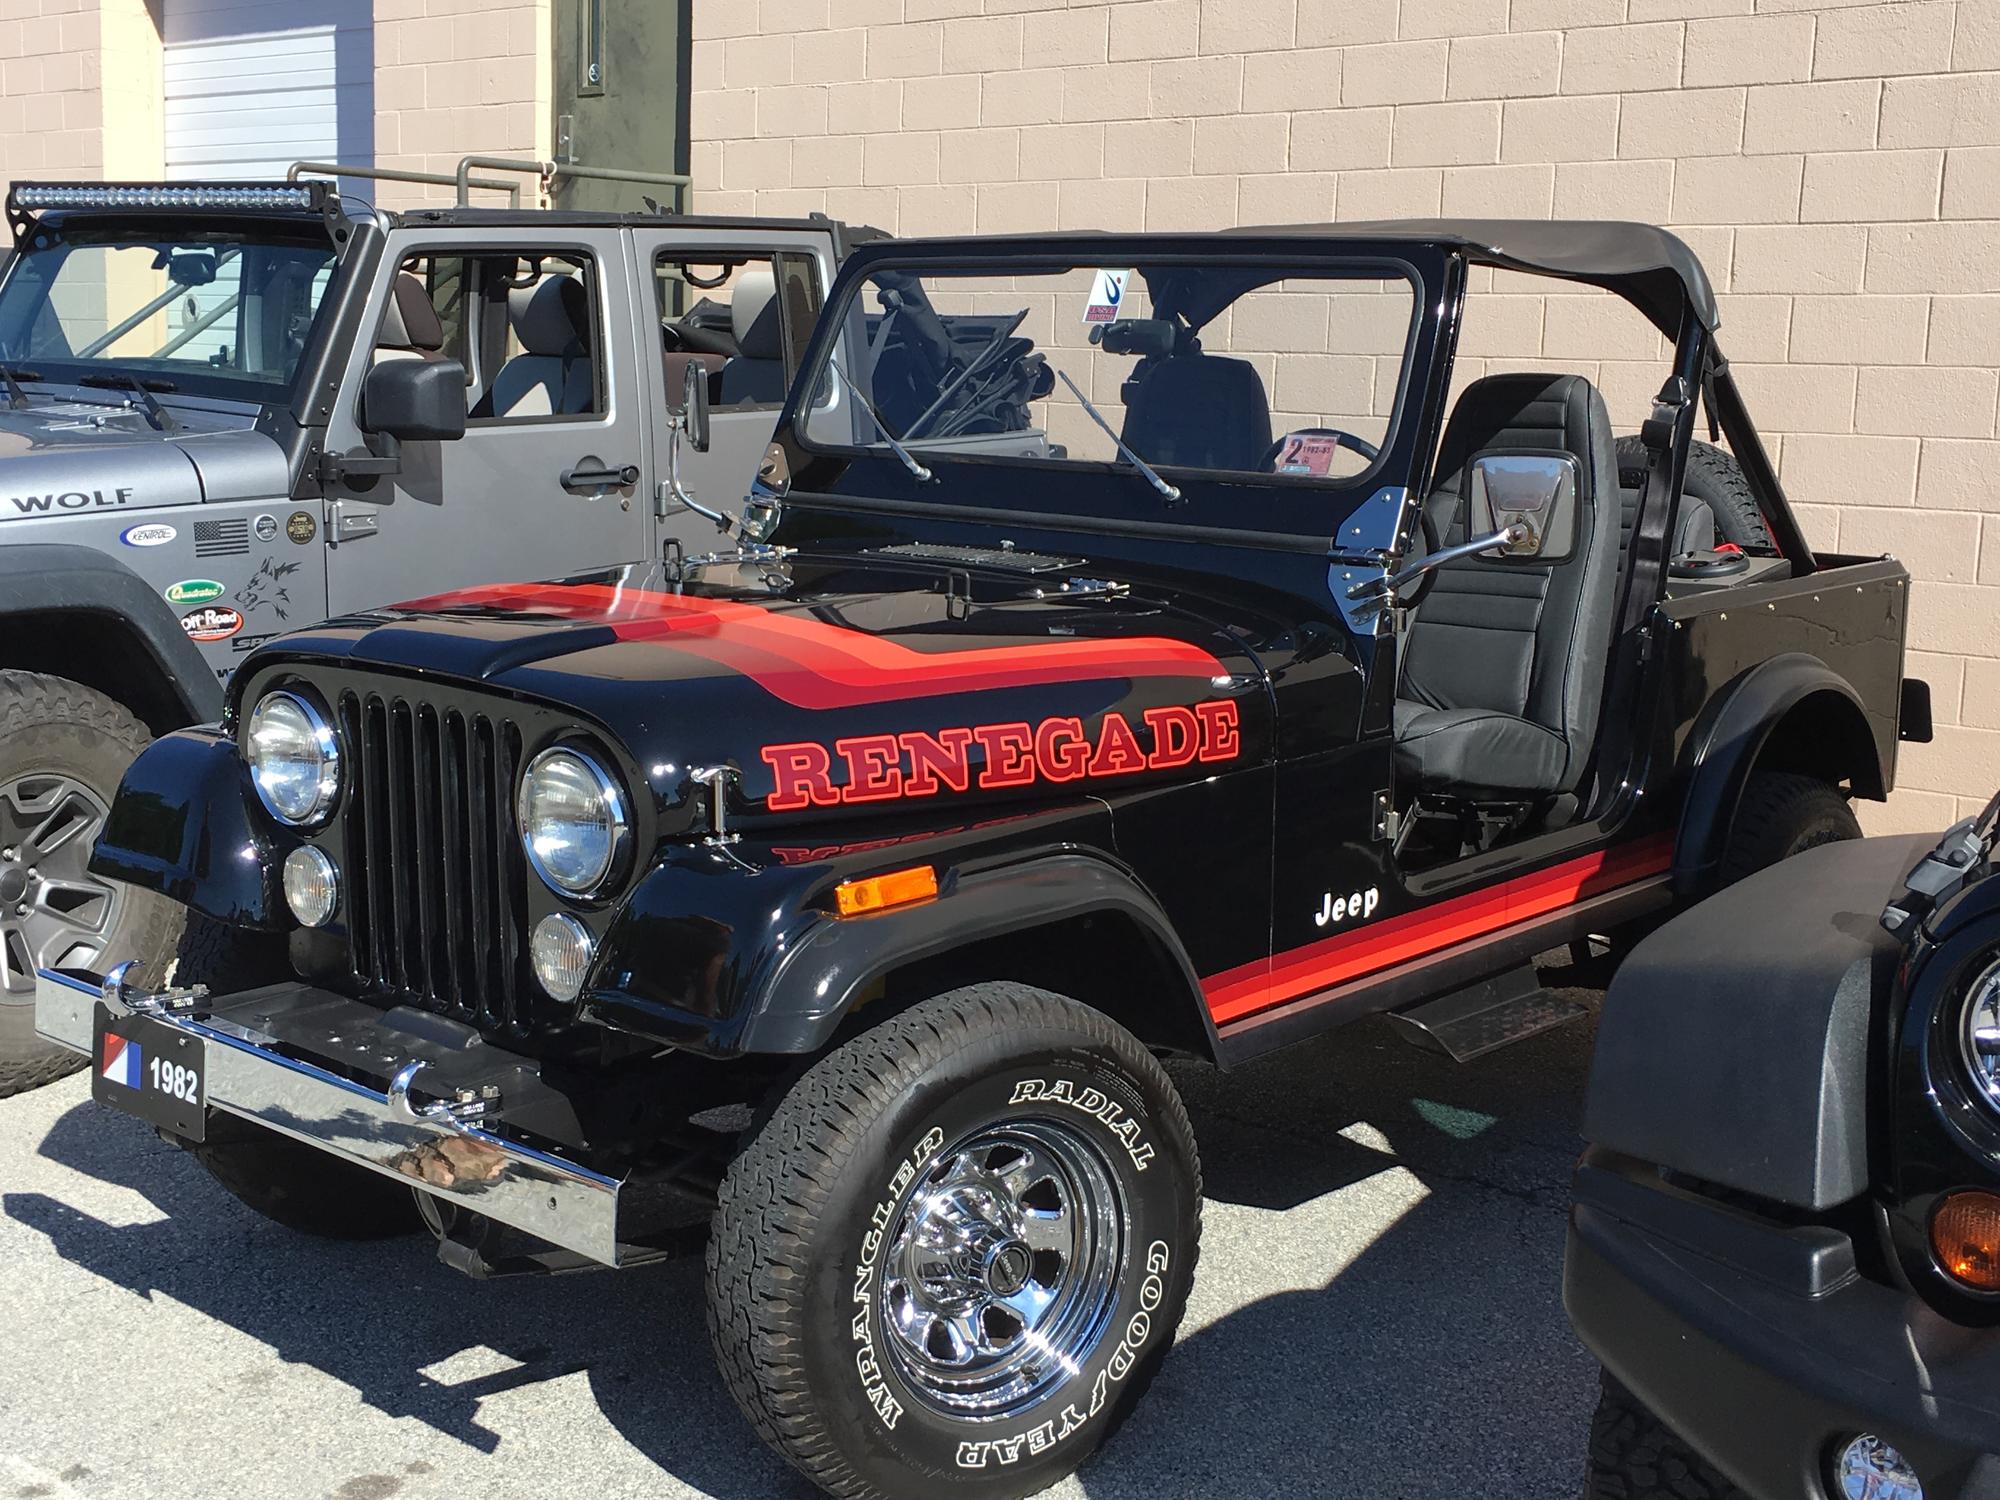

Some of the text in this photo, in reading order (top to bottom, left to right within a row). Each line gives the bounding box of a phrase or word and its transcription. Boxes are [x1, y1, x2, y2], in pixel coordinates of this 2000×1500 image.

[1286, 438, 1303, 464] 2
[11, 488, 133, 513] WOLF
[205, 609, 237, 626] Road
[760, 699, 1239, 811] RENEGADE
[1314, 887, 1379, 927] Jeep
[150, 1056, 198, 1105] 1982
[1008, 1079, 1155, 1171] RADIAL
[853, 1126, 944, 1430] WRANGLER
